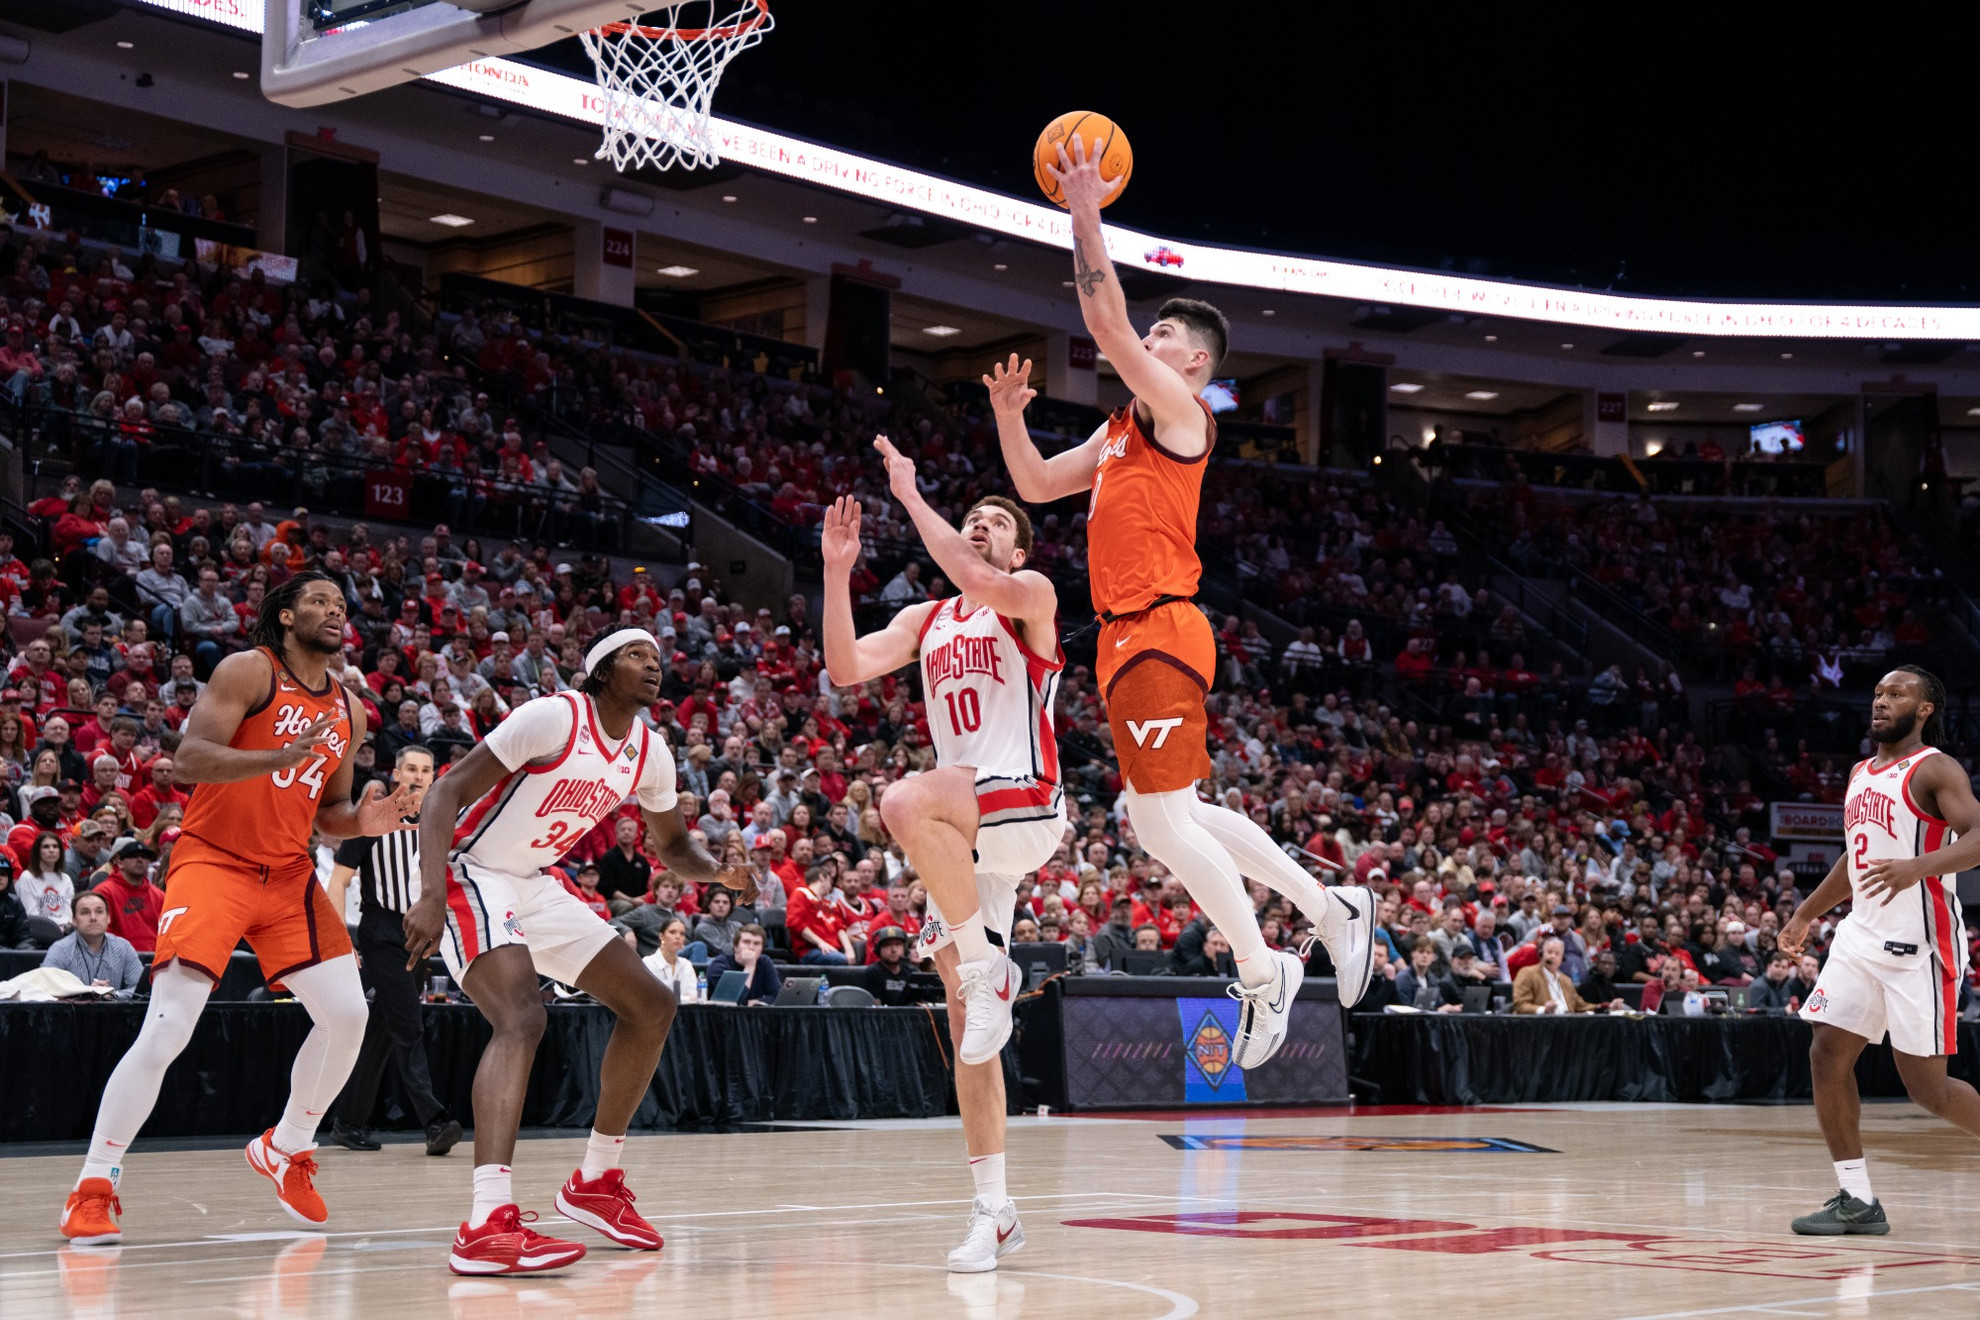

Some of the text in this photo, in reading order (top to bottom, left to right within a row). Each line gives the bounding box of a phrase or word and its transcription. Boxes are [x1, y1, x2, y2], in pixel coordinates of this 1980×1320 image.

[748, 139, 791, 165] BEEN
[605, 239, 630, 256] 224
[372, 483, 404, 505] 123
[952, 634, 1006, 686] STATE
[944, 687, 982, 737] 10
[1124, 716, 1185, 750] VT
[1860, 786, 1898, 841] STATE
[530, 820, 588, 858] 34
[1853, 833, 1869, 870] 2
[1198, 1043, 1226, 1057] NIT
